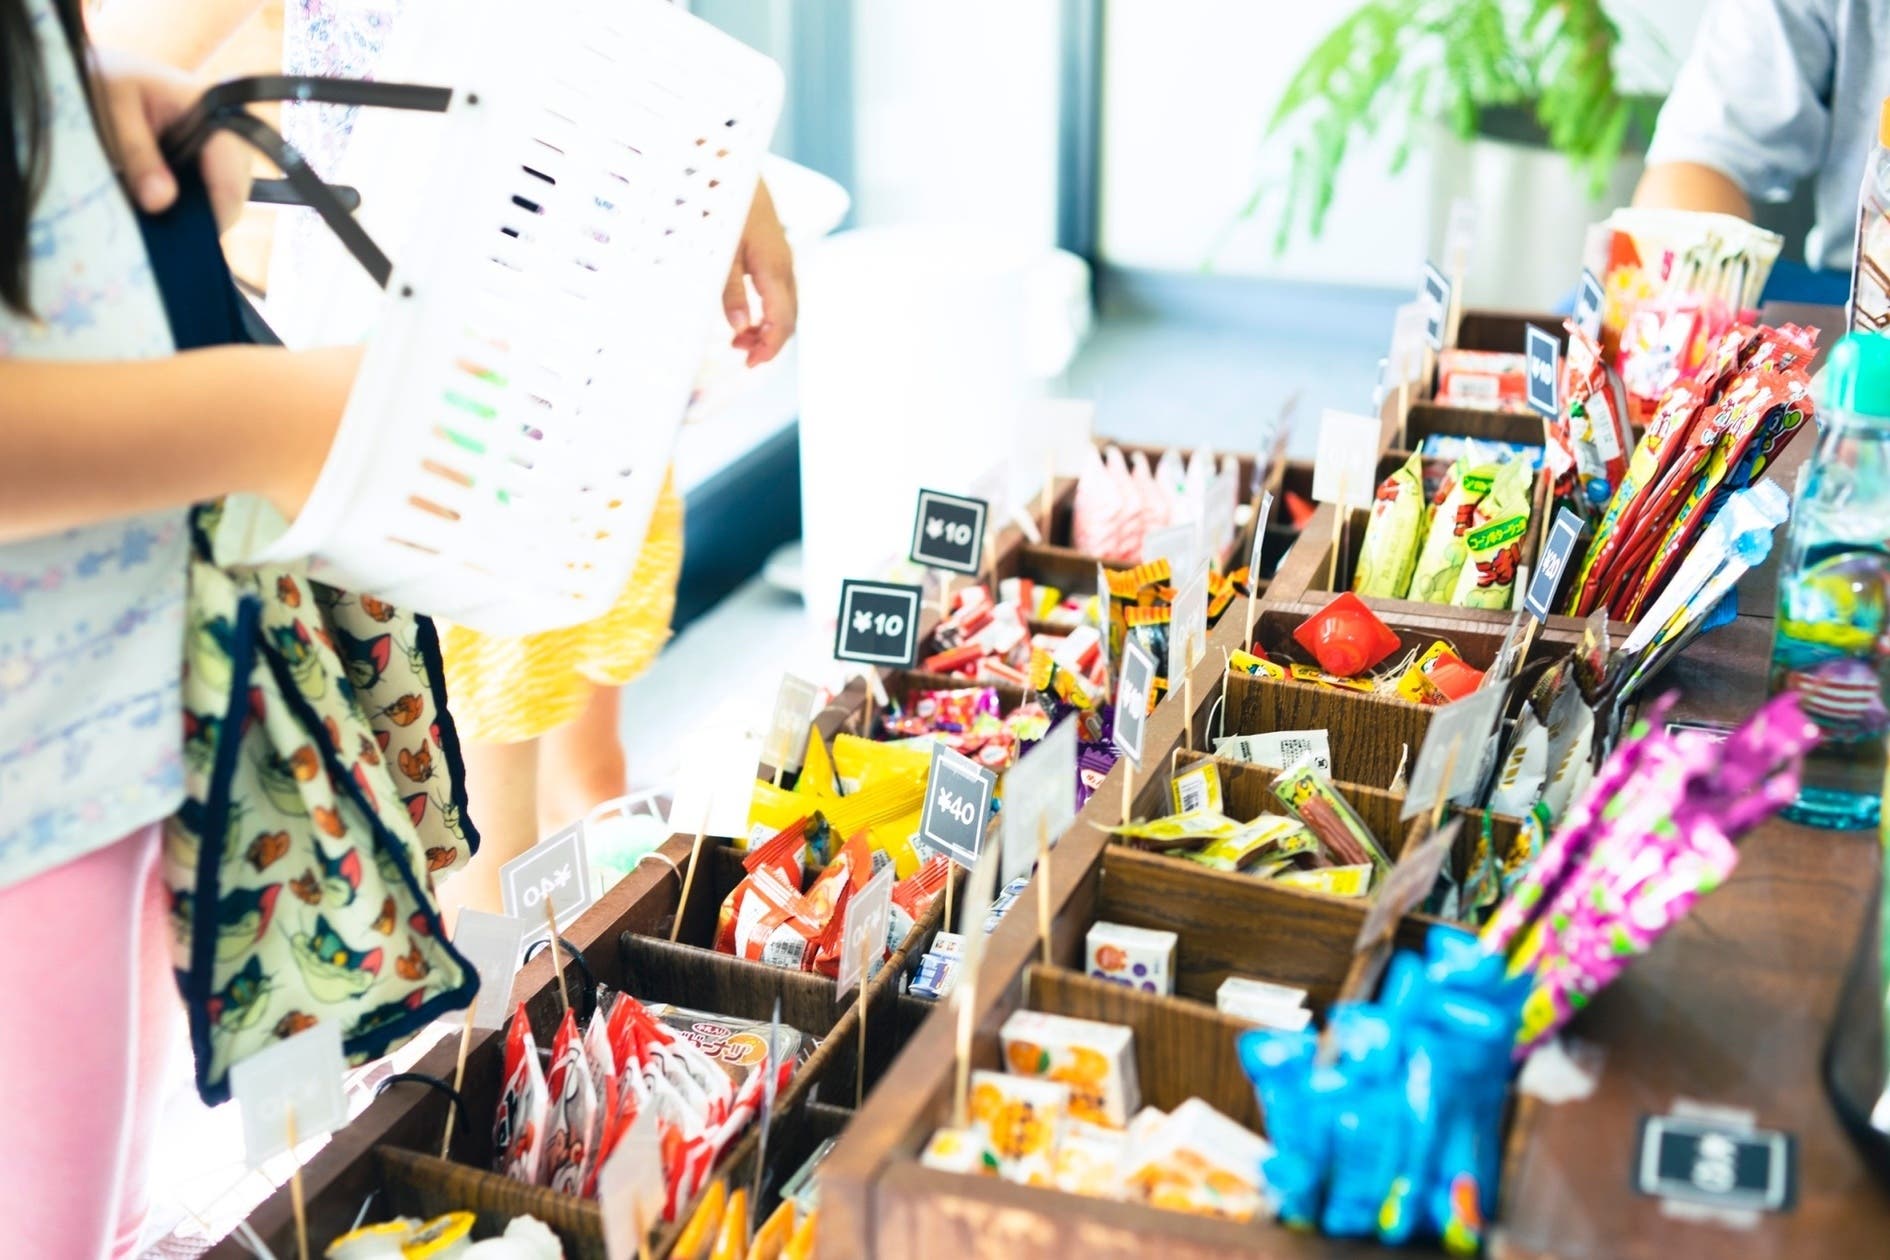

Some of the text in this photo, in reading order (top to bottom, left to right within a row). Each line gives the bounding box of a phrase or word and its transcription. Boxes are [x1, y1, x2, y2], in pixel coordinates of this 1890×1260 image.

[925, 516, 972, 546] ¥10
[852, 610, 904, 637] ¥10
[937, 786, 976, 826] ¥40
[681, 1030, 748, 1061] ドーナツ
